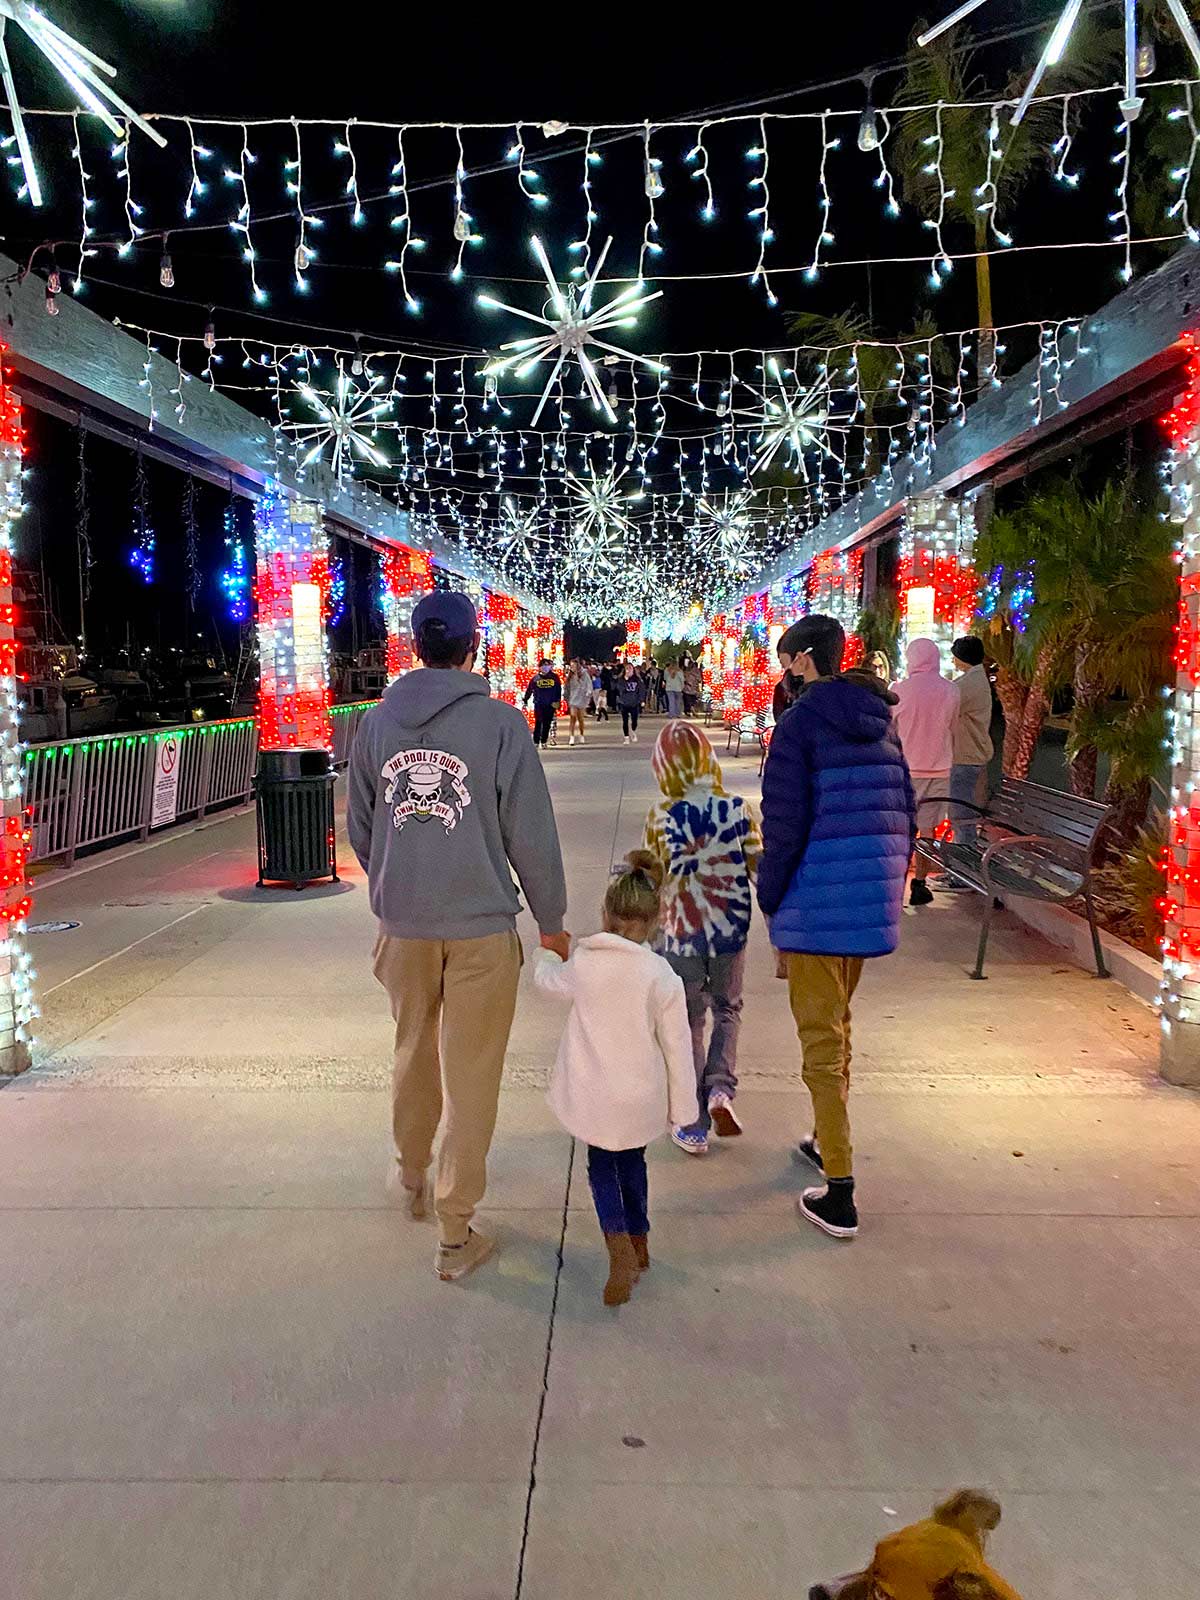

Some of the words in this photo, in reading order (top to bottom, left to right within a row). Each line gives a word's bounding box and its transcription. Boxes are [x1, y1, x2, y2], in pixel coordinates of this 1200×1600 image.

[388, 758, 403, 773] THE
[403, 752, 427, 765] POOL
[429, 752, 439, 763] IS
[439, 755, 461, 774] OURS
[435, 804, 449, 816] DIVE
